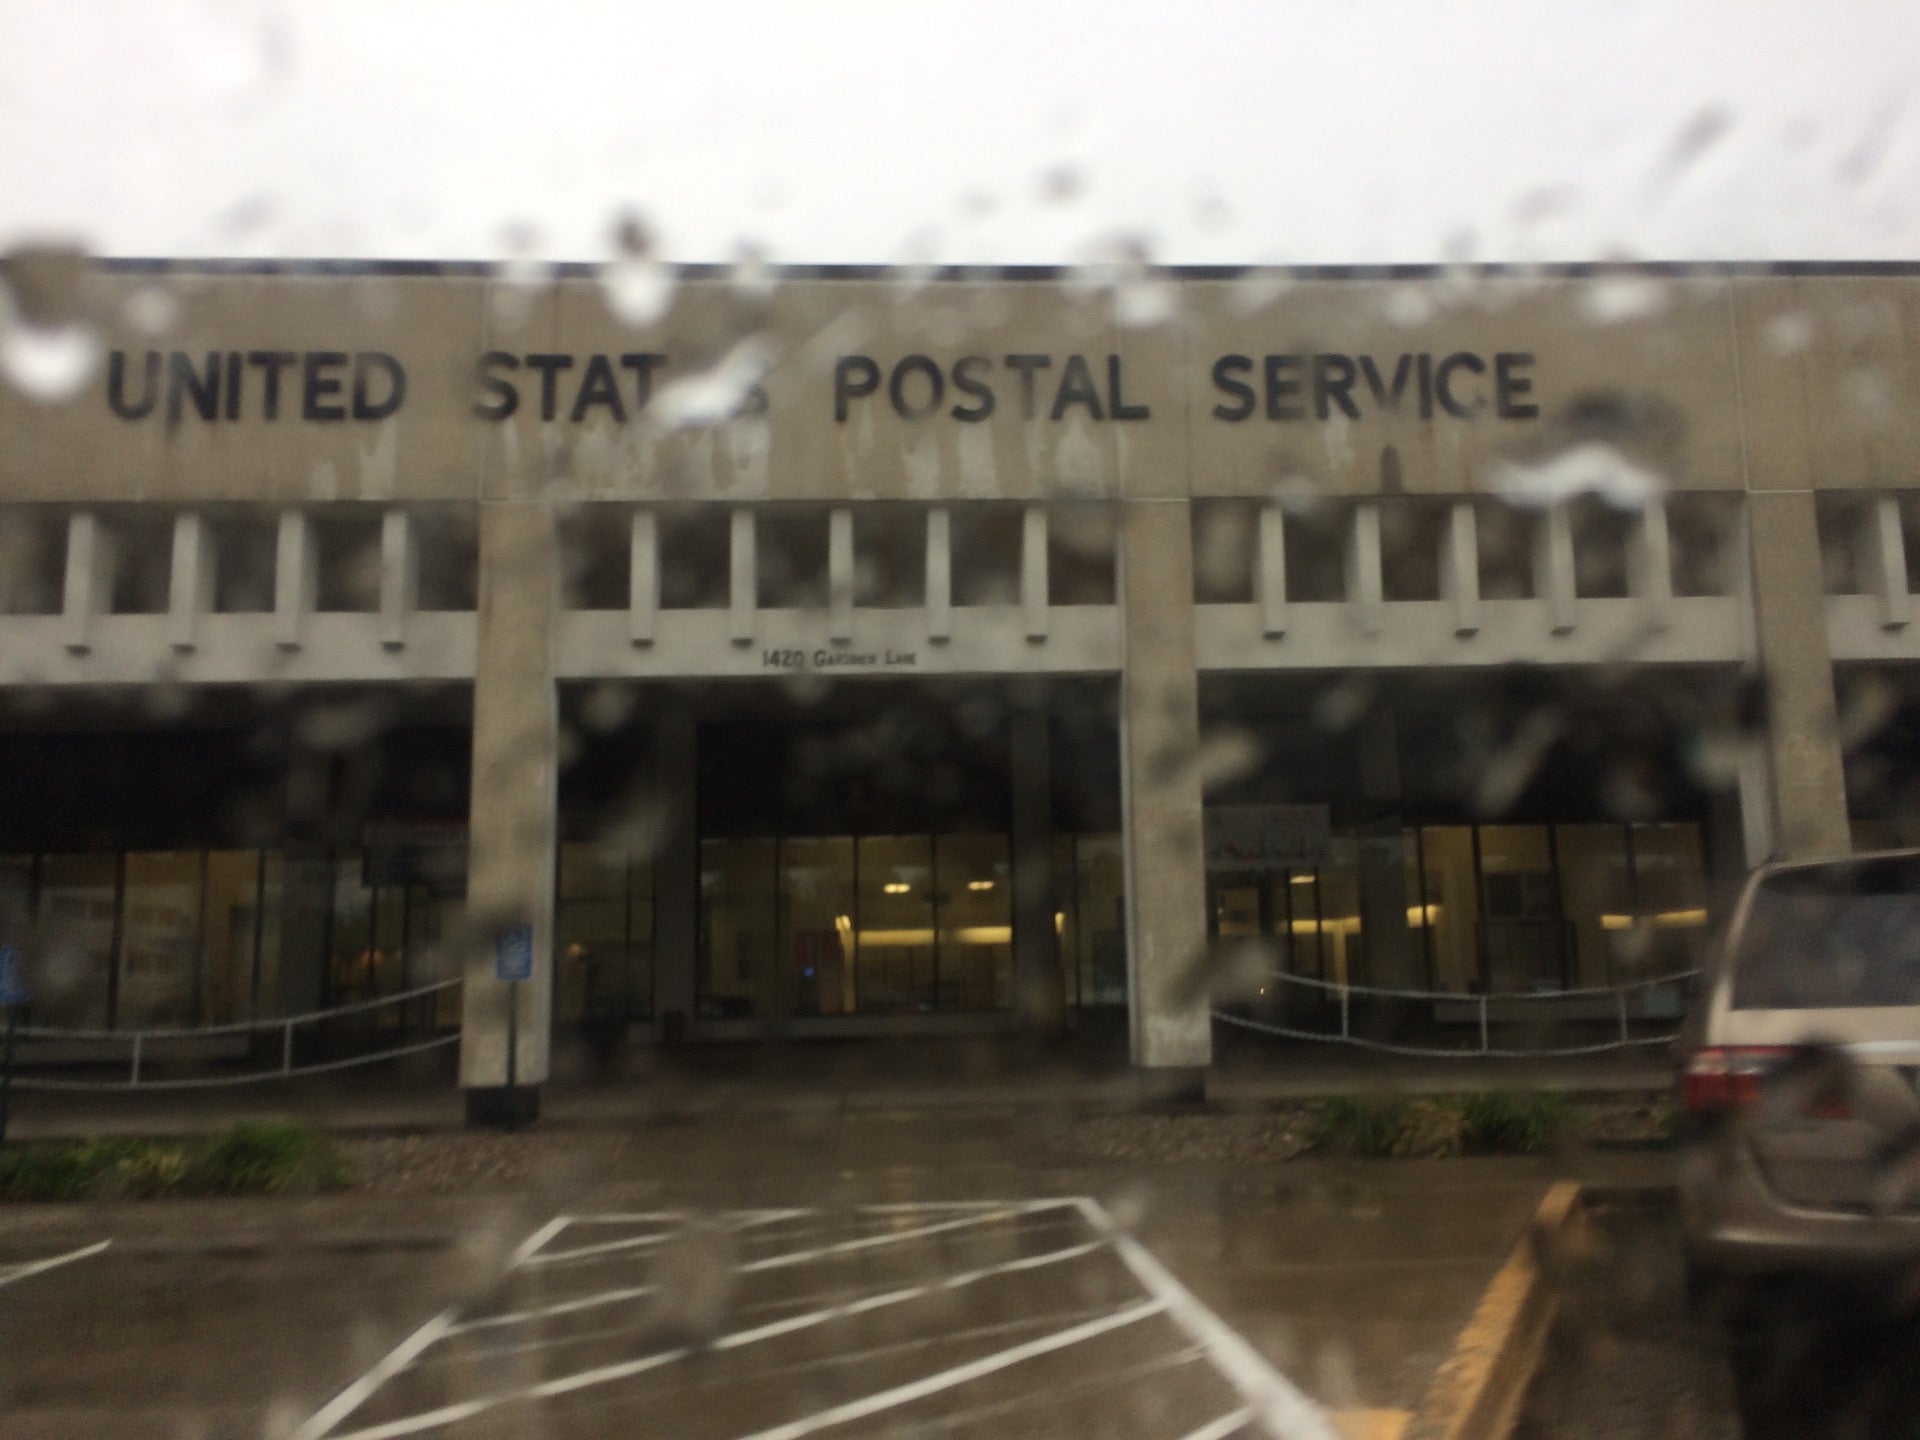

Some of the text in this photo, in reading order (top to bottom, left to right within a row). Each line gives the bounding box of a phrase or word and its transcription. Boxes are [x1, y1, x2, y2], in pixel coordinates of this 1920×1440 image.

[107, 350, 1539, 423] UNITED STATS POSTAL SERVICE
[762, 650, 805, 667] 1420
